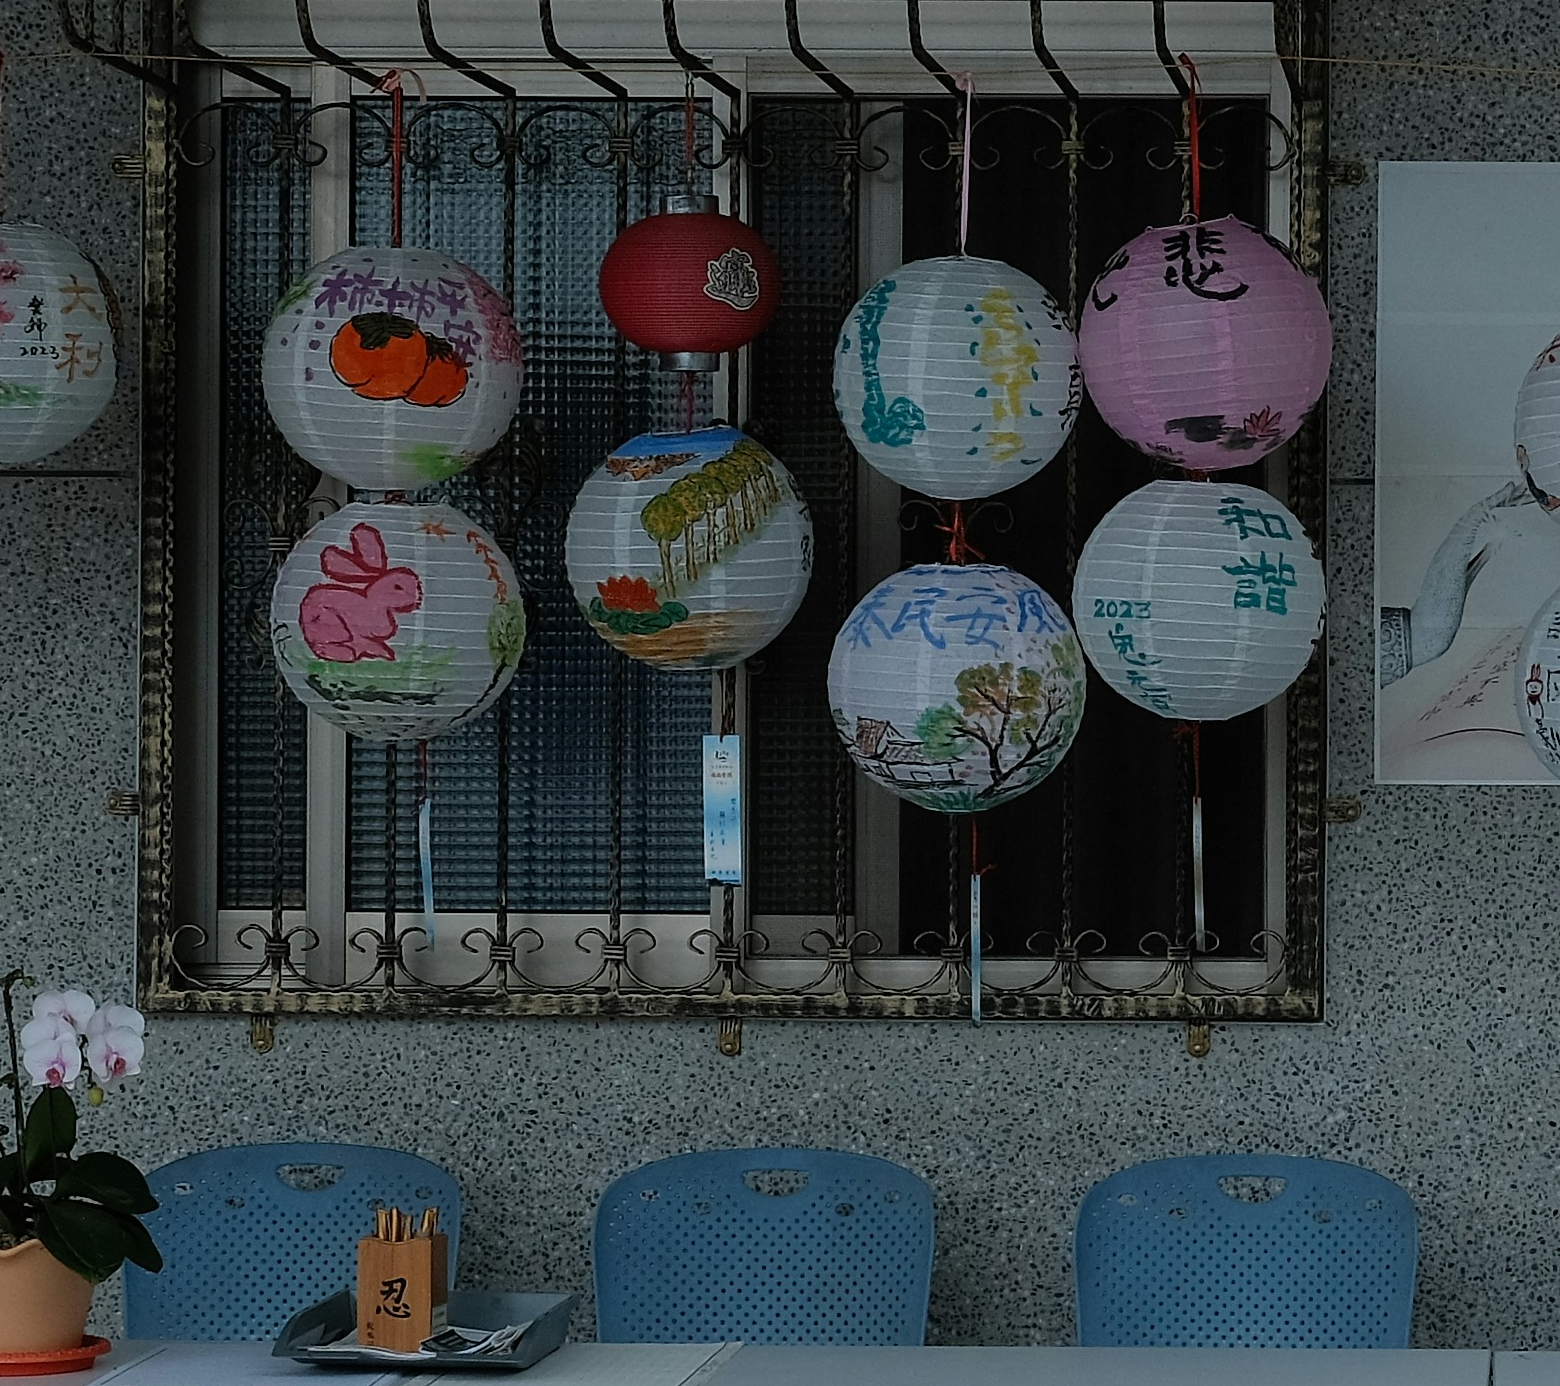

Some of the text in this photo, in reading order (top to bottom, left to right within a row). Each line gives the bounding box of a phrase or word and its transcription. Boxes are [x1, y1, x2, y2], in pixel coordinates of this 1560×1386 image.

[1163, 226, 1249, 301] 悲
[20, 346, 59, 359] 2023
[1094, 599, 1151, 618] 2023
[376, 1278, 411, 1319] 忍
